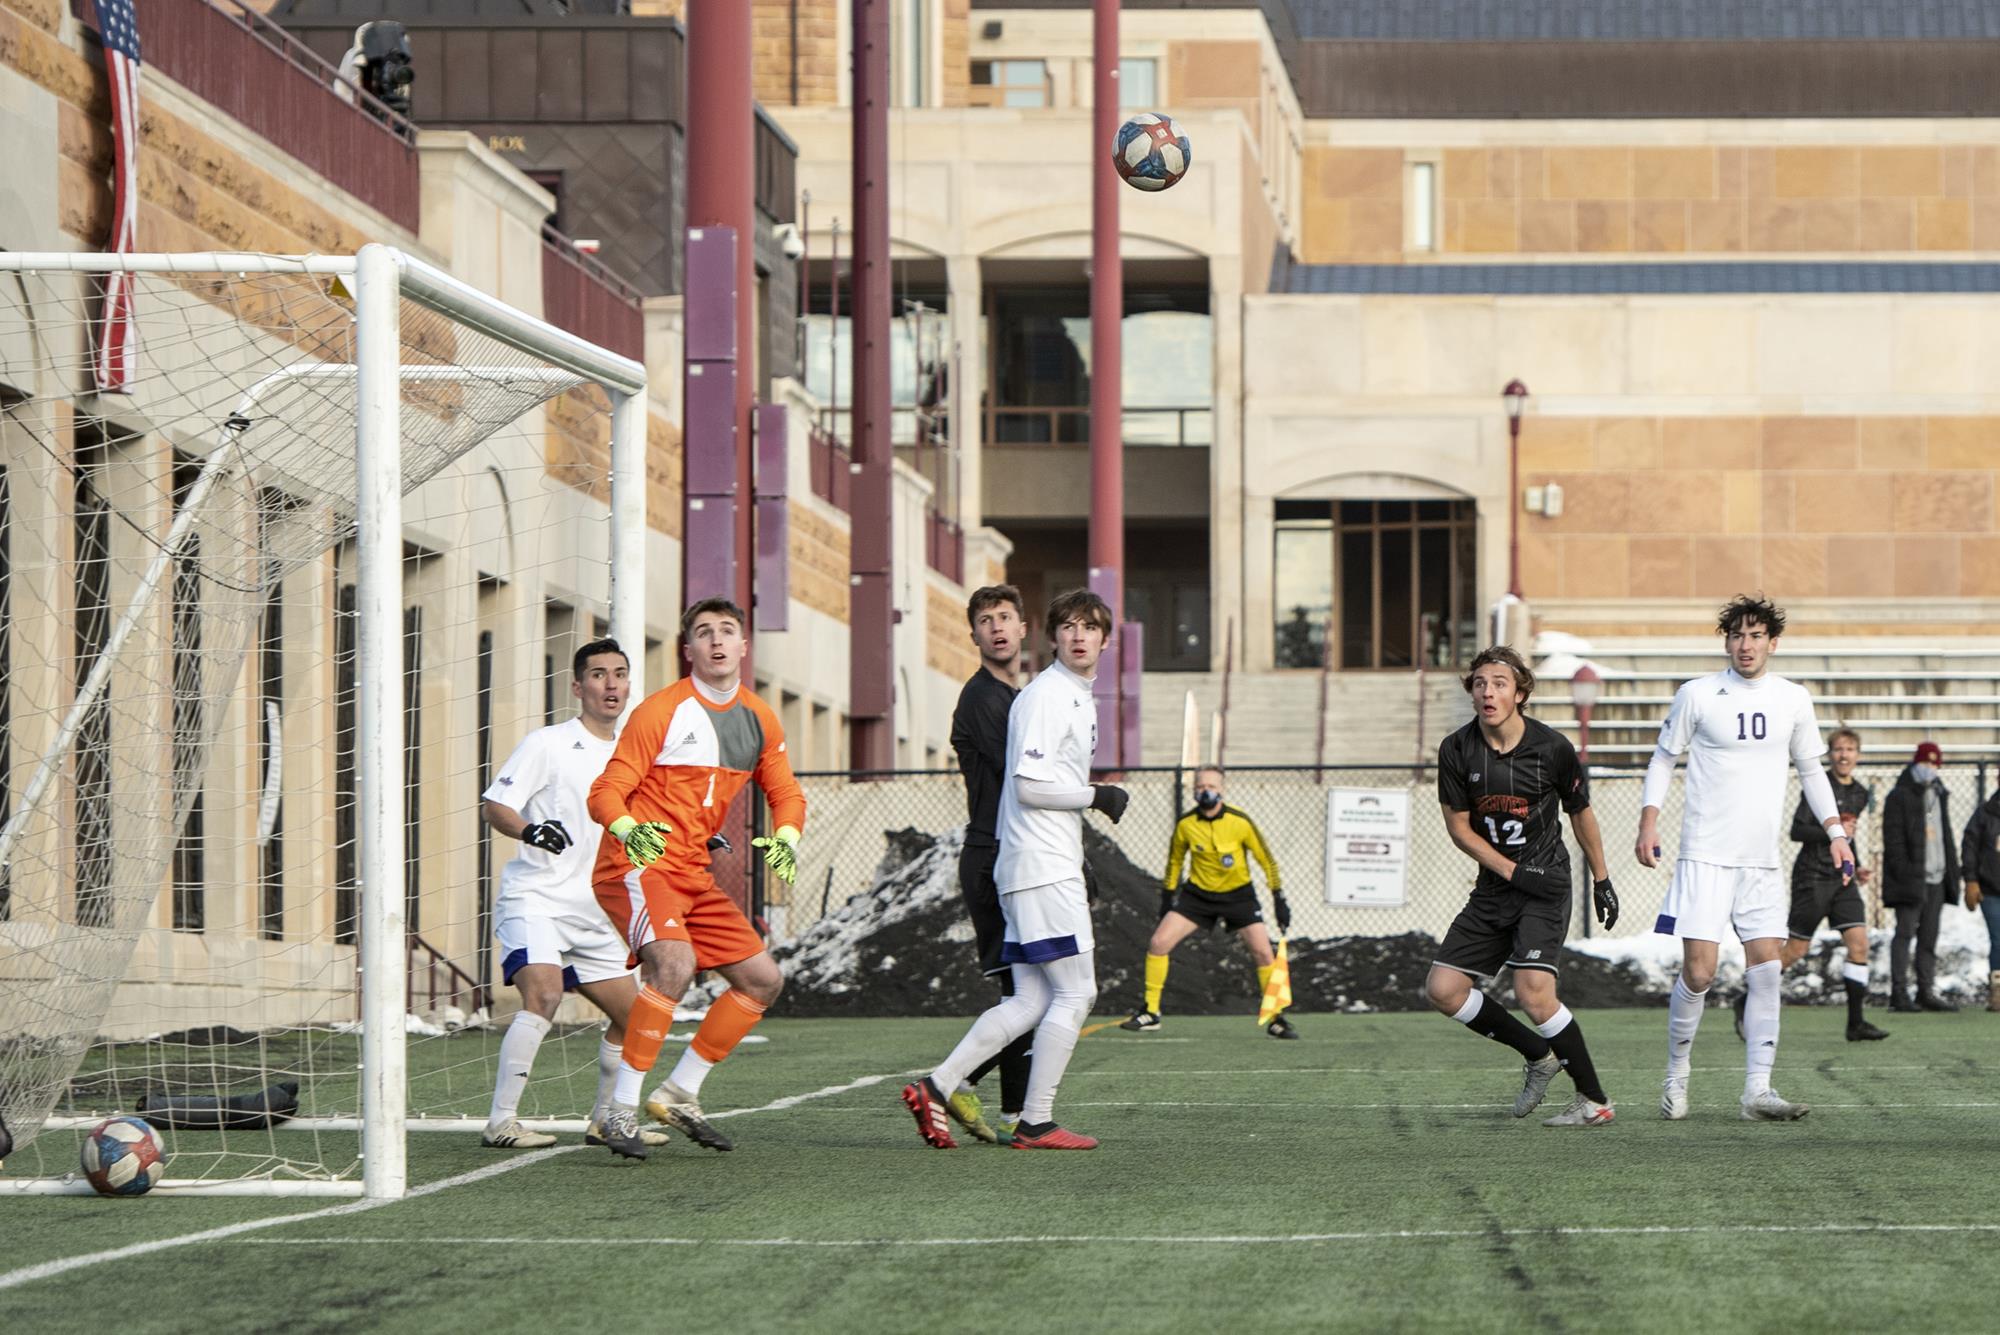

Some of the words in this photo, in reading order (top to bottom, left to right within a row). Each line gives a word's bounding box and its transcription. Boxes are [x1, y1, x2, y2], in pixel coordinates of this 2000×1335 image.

[1737, 712, 1767, 740] 10
[702, 773, 716, 807] 1
[1484, 815, 1527, 845] 12
